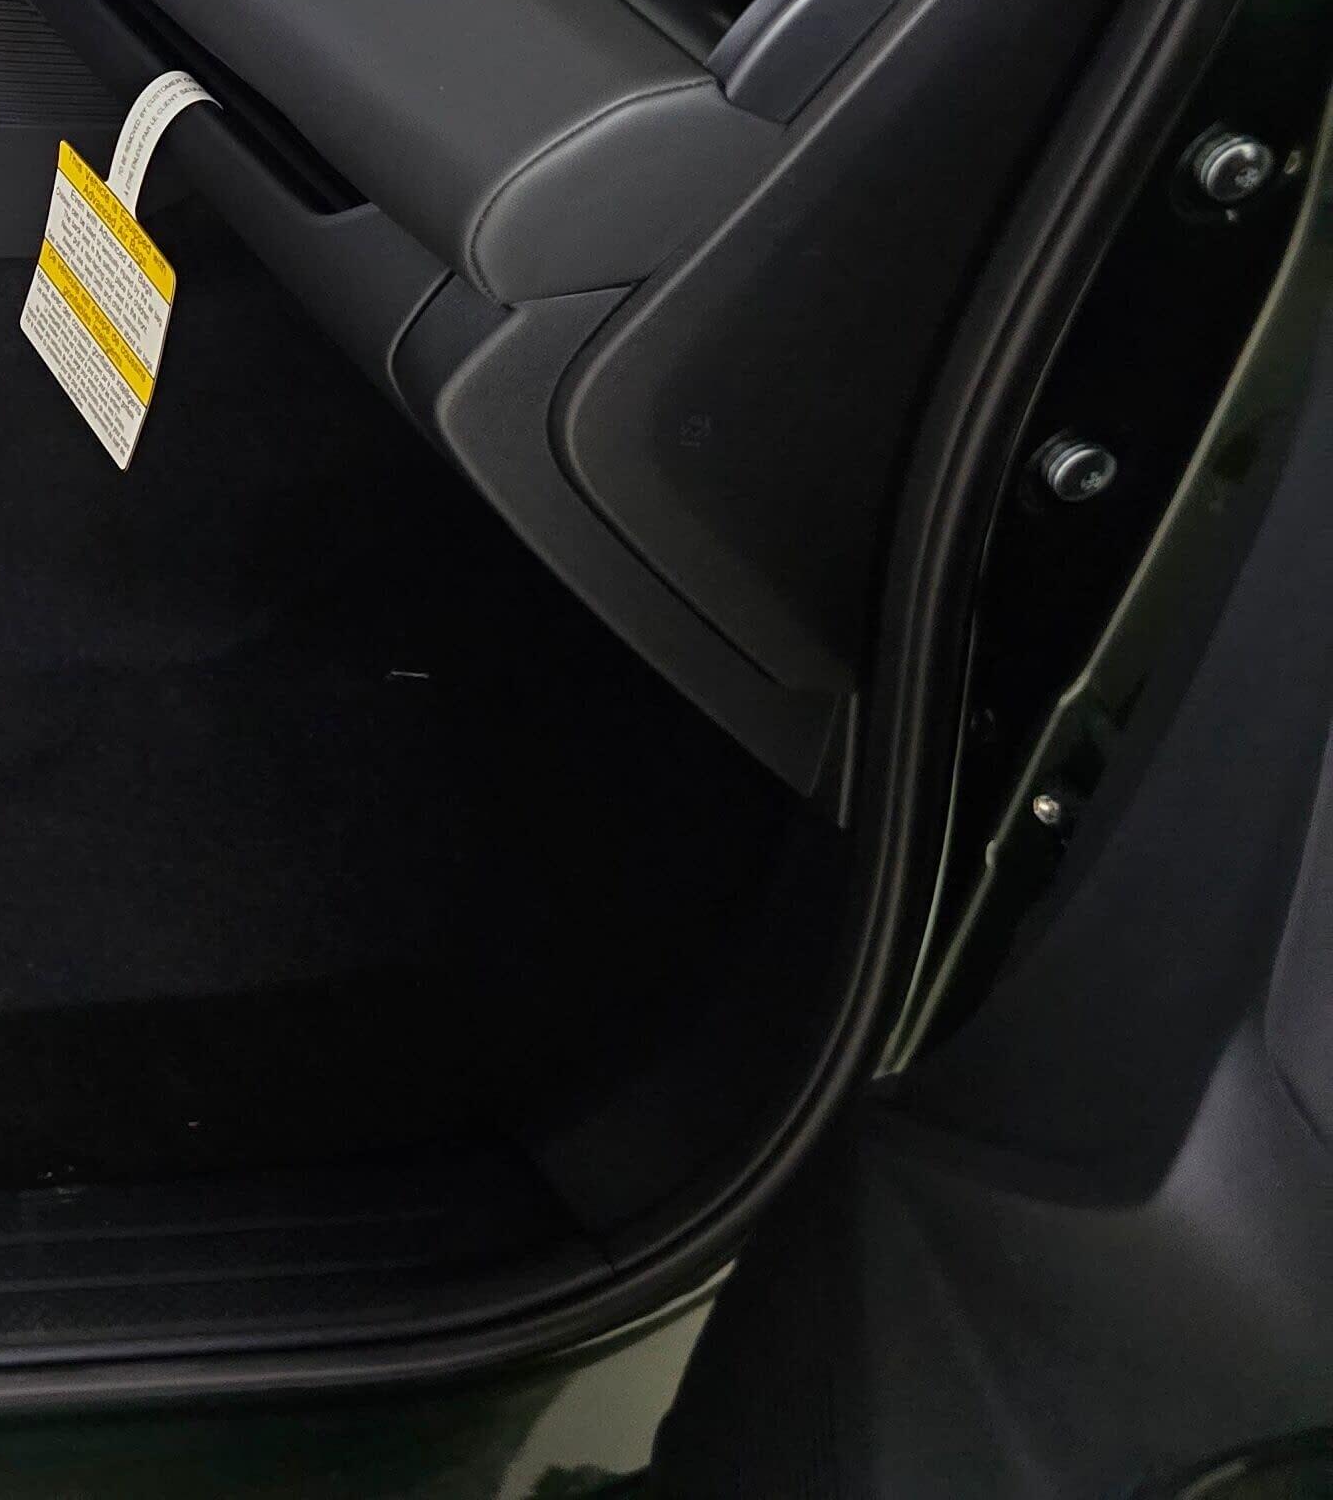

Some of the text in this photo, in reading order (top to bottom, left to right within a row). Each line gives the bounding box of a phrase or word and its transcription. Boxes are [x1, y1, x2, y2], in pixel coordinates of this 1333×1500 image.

[67, 148, 168, 277] This Vehicle is Equipped with
[69, 188, 154, 300] Even with Advanced Air Bags
[82, 181, 148, 271] Advanced Air Bags
